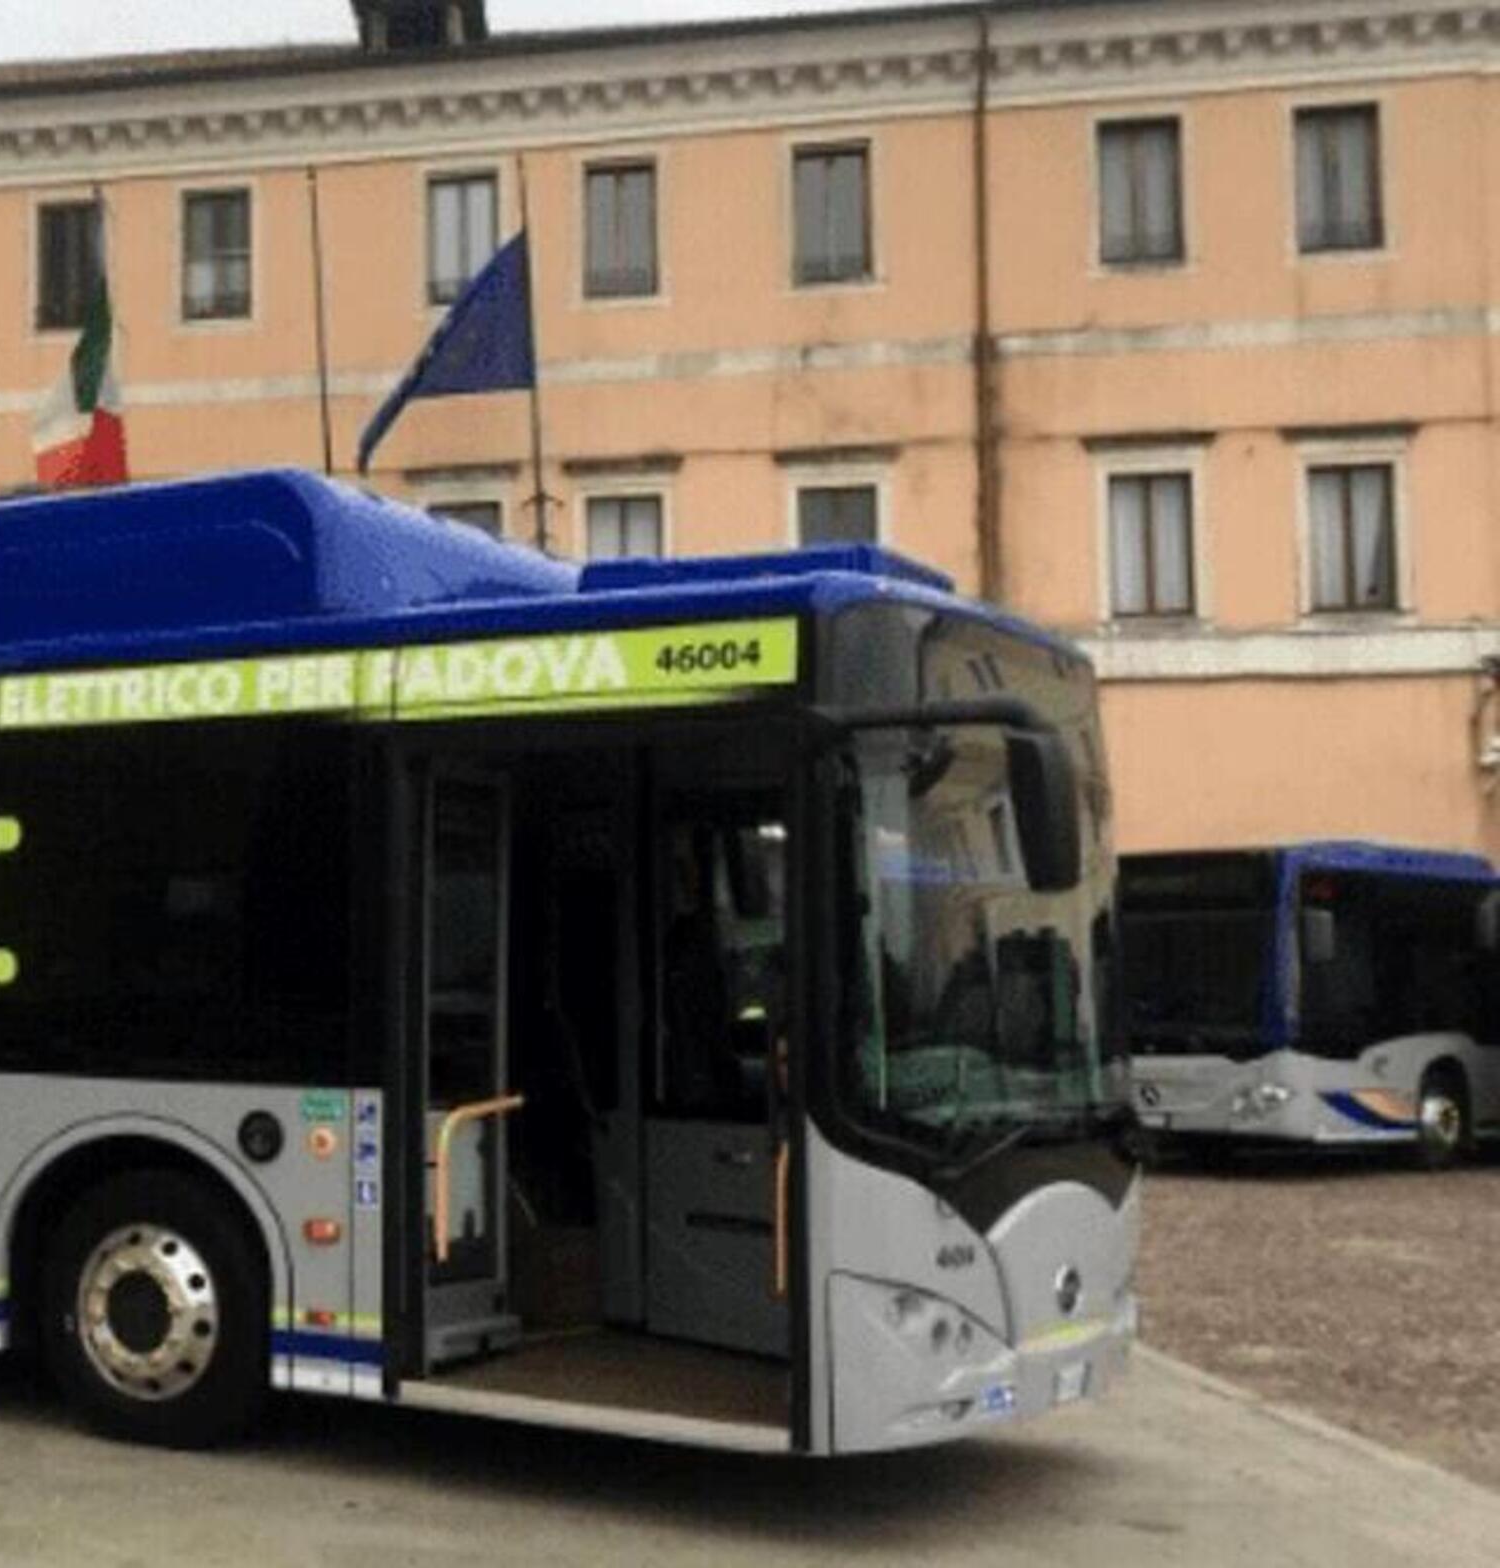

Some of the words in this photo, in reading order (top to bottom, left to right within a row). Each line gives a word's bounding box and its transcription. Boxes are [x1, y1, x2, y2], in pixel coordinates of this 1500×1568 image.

[0, 661, 243, 727] ELETTRICO
[257, 650, 352, 712] PER
[370, 633, 629, 704] PADOVA
[656, 640, 761, 674] 46004
